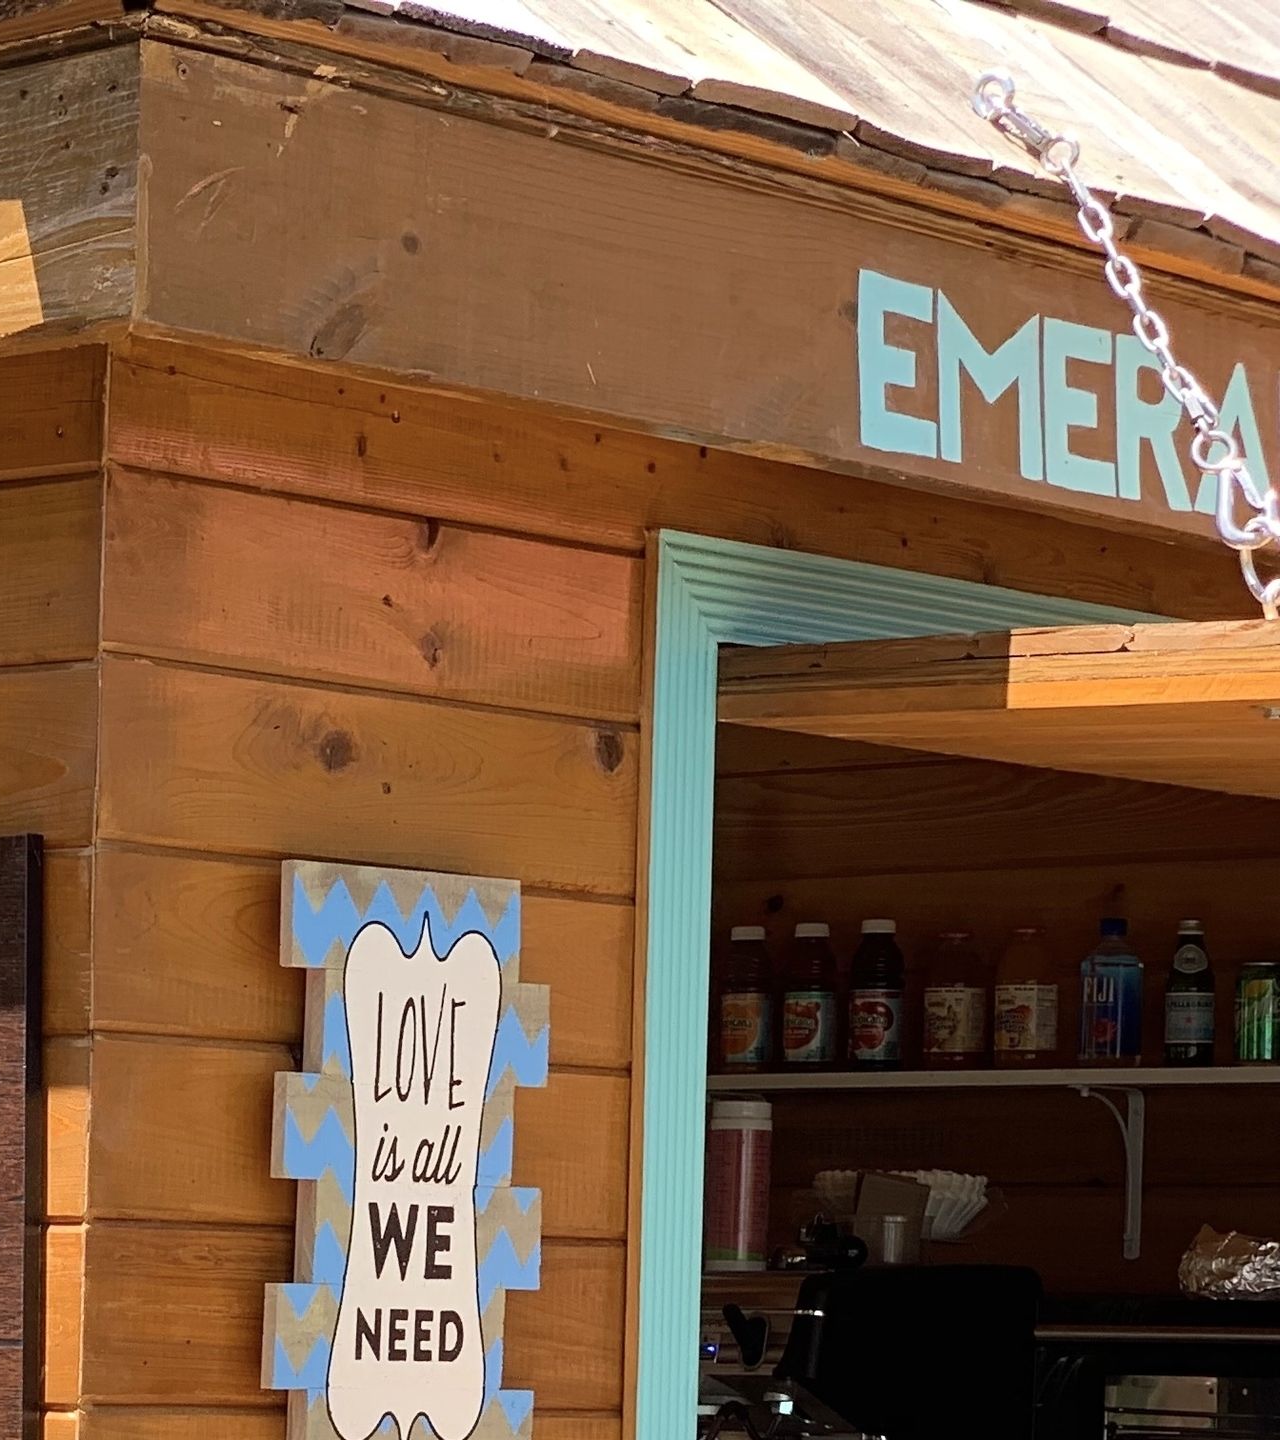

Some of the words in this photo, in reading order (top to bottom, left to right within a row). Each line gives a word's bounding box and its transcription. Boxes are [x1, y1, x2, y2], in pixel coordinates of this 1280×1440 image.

[857, 268, 1280, 517] EMERA
[1083, 976, 1115, 1002] FIJI
[372, 983, 467, 1110] LOVE
[372, 1122, 405, 1183] is
[411, 1124, 463, 1185] all
[368, 1202, 456, 1281] WE
[354, 1307, 465, 1363] NEED
